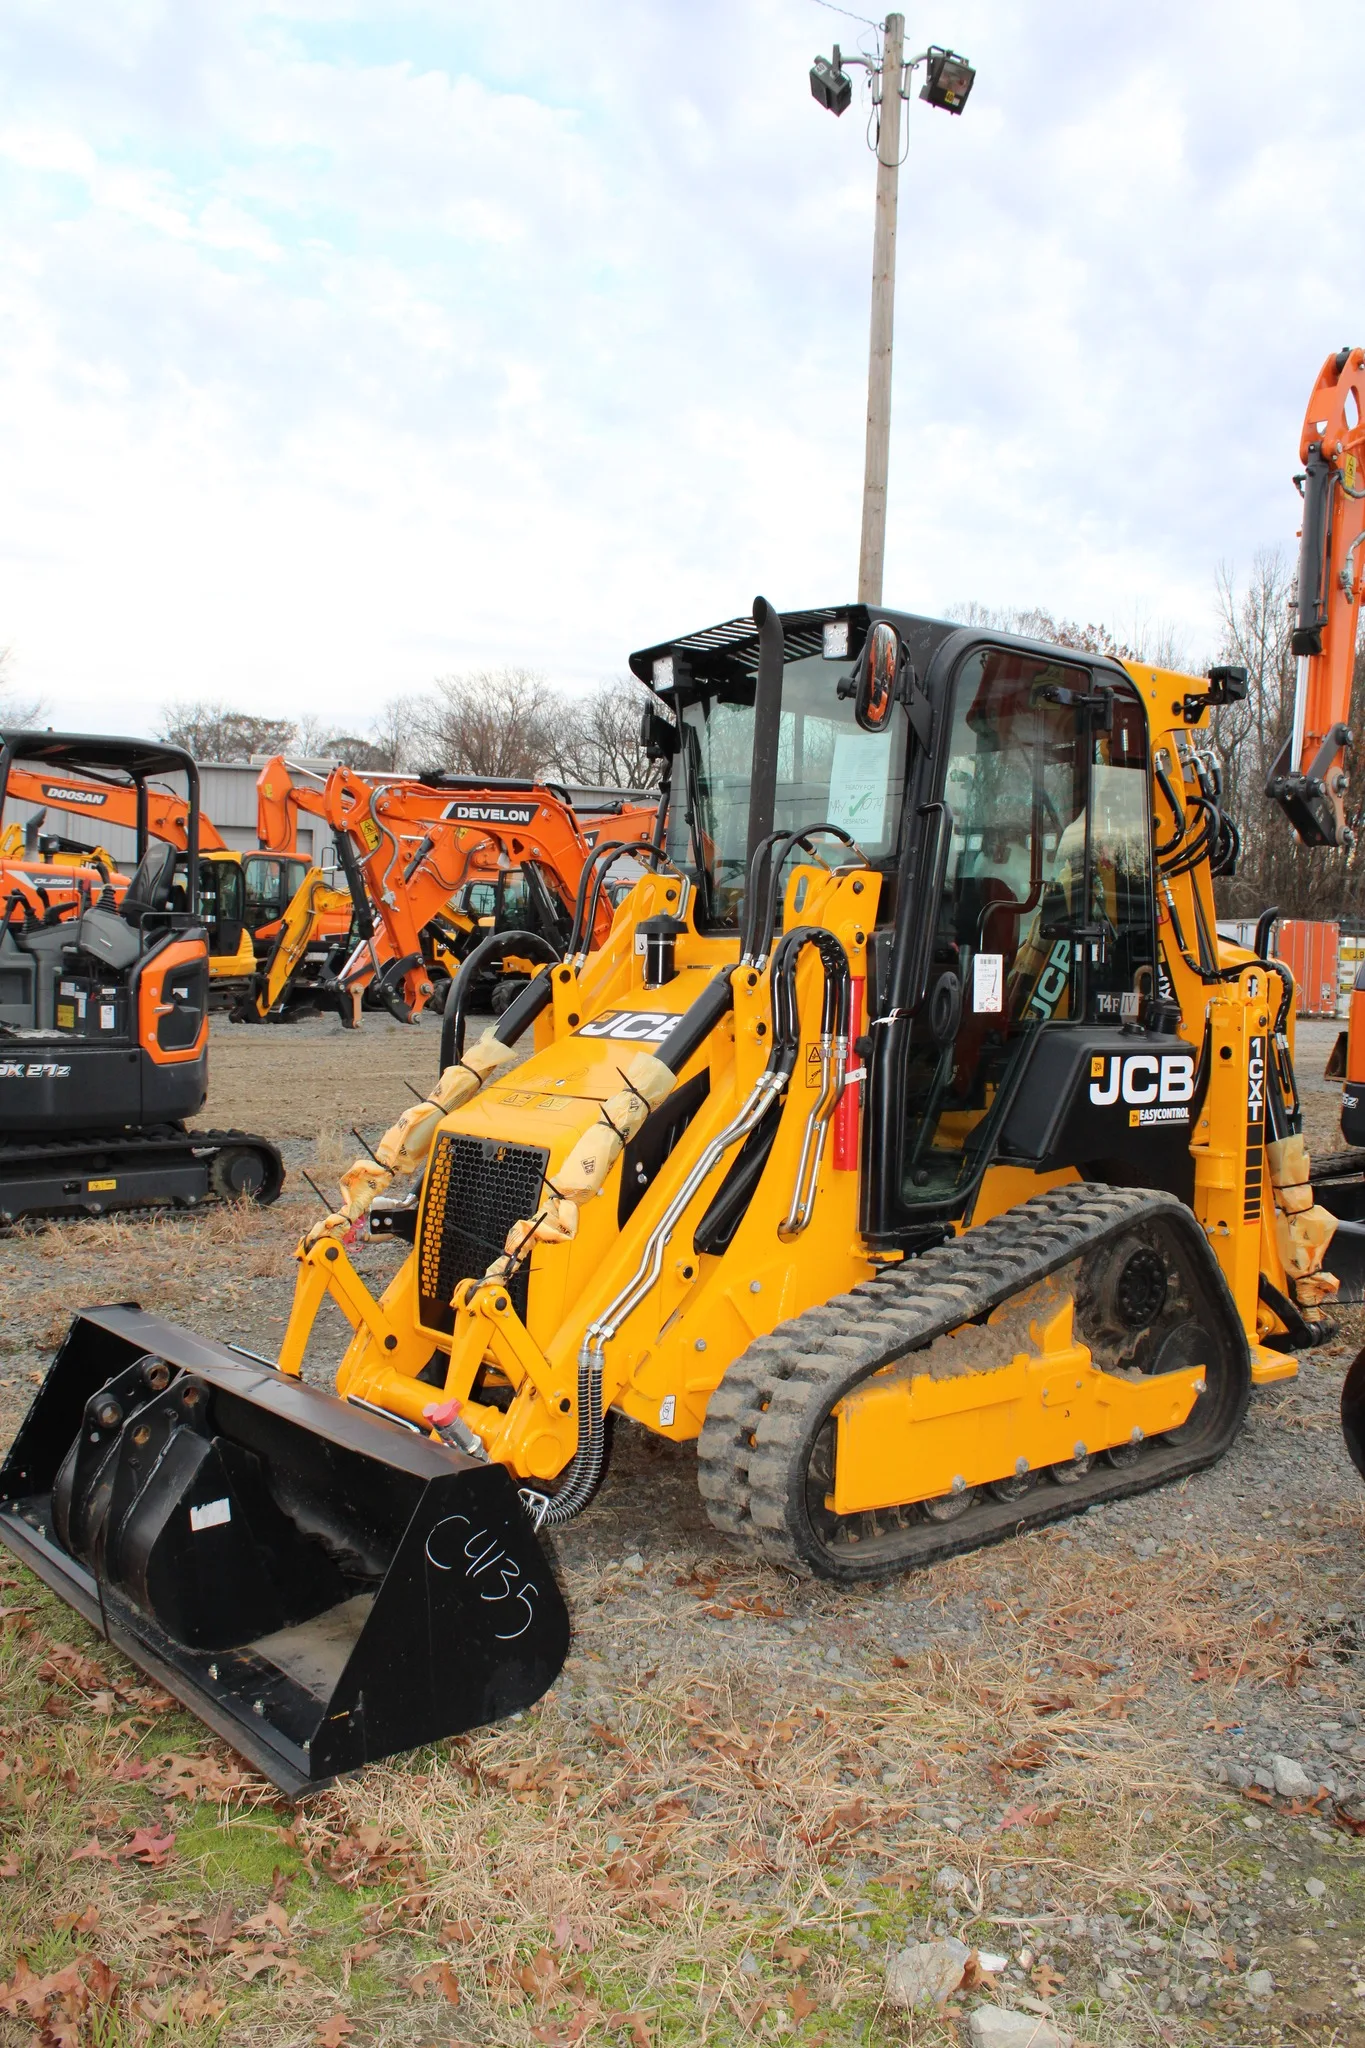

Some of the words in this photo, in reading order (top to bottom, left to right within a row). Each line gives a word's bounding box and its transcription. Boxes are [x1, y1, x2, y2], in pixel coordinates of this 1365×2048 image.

[47, 788, 104, 804] DOOSAN
[457, 806, 530, 822] DEVELON
[1089, 1055, 1195, 1106] JCB
[1247, 1037, 1264, 1122] 1CXT
[1139, 1107, 1190, 1122] EASYCONTROL
[582, 1159, 595, 1174] JCB
